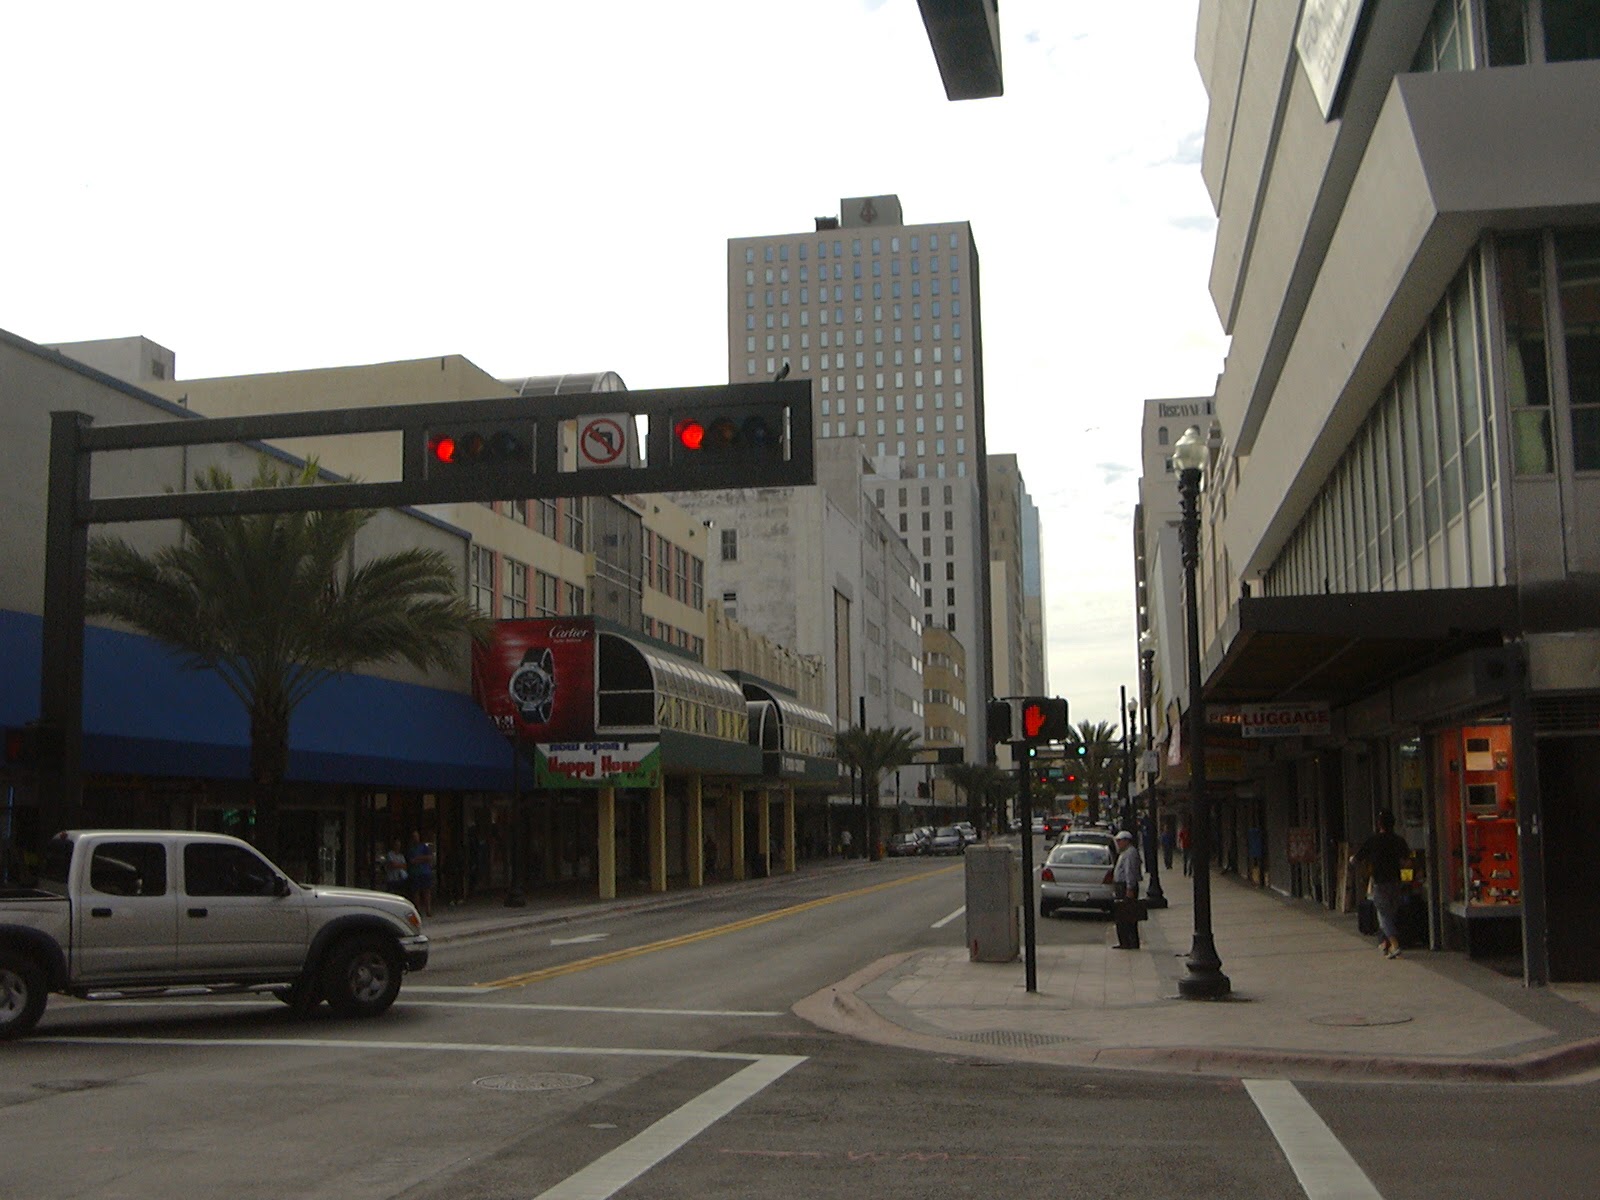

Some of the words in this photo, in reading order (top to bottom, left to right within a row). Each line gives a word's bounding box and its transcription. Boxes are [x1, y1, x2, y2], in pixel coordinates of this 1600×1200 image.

[549, 626, 589, 638] Cartier
[1244, 711, 1329, 726] LUGGAGE
[548, 756, 594, 778] Happy
[602, 756, 641, 772] Hour
